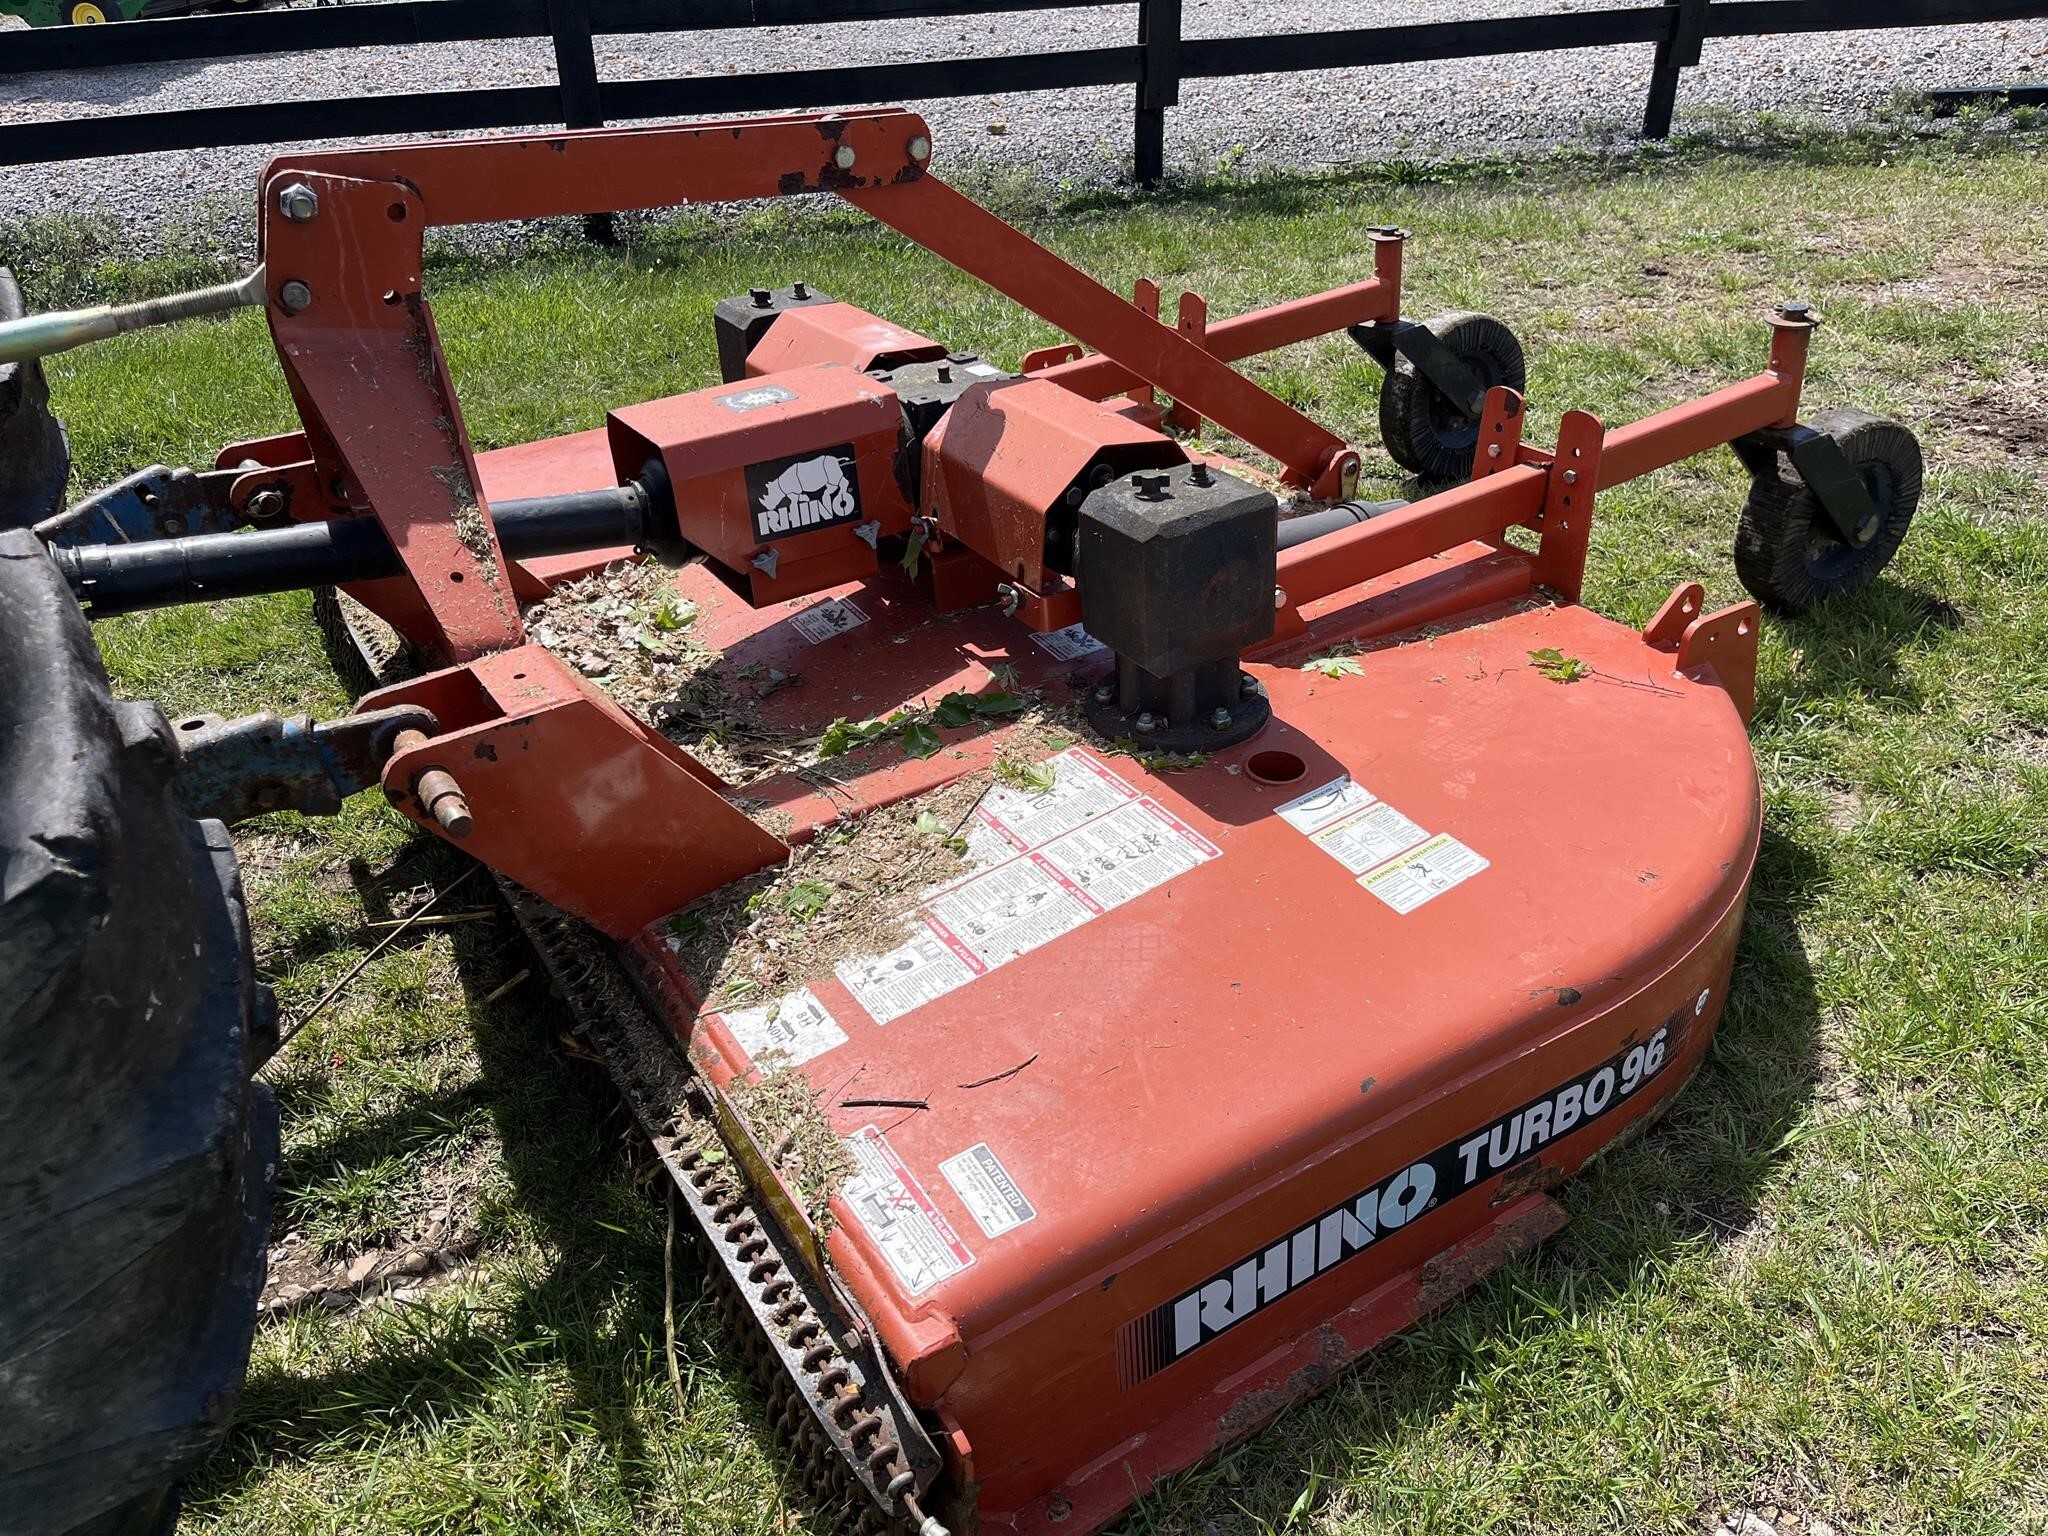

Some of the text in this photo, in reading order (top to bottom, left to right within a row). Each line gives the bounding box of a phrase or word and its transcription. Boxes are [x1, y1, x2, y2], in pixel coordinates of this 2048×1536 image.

[758, 493, 855, 536] RHINO
[981, 1158, 1024, 1208] PATENTED
[1173, 1027, 1668, 1357] RHINO TURBO 96
